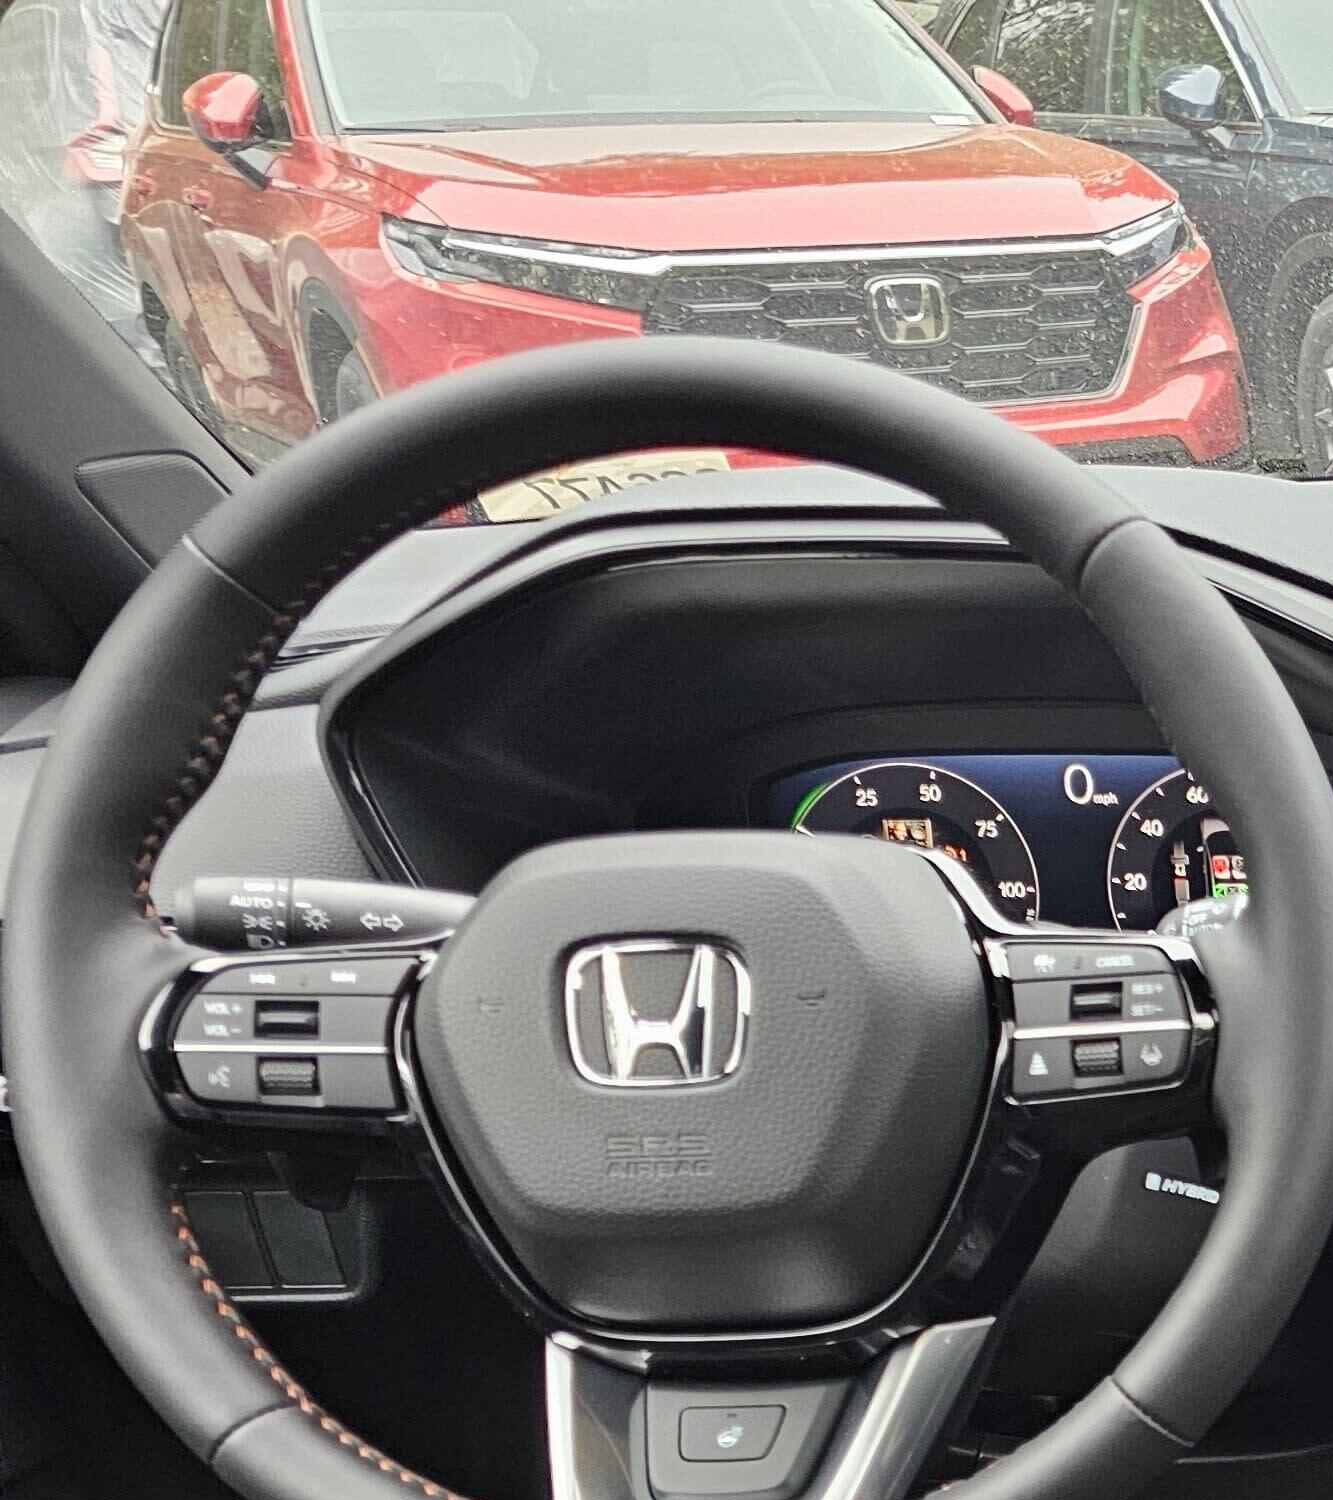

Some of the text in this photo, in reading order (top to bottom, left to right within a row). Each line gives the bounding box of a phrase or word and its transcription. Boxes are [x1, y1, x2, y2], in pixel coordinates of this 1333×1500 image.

[919, 785, 942, 802] 50
[1064, 764, 1118, 806] 0 mph
[855, 788, 878, 807] 25
[1186, 786, 1209, 804] 60
[975, 820, 999, 838] 75
[1140, 818, 1164, 837] 40
[998, 881, 1026, 898] 100
[1124, 873, 1147, 891] 20
[229, 894, 274, 909] AUTO
